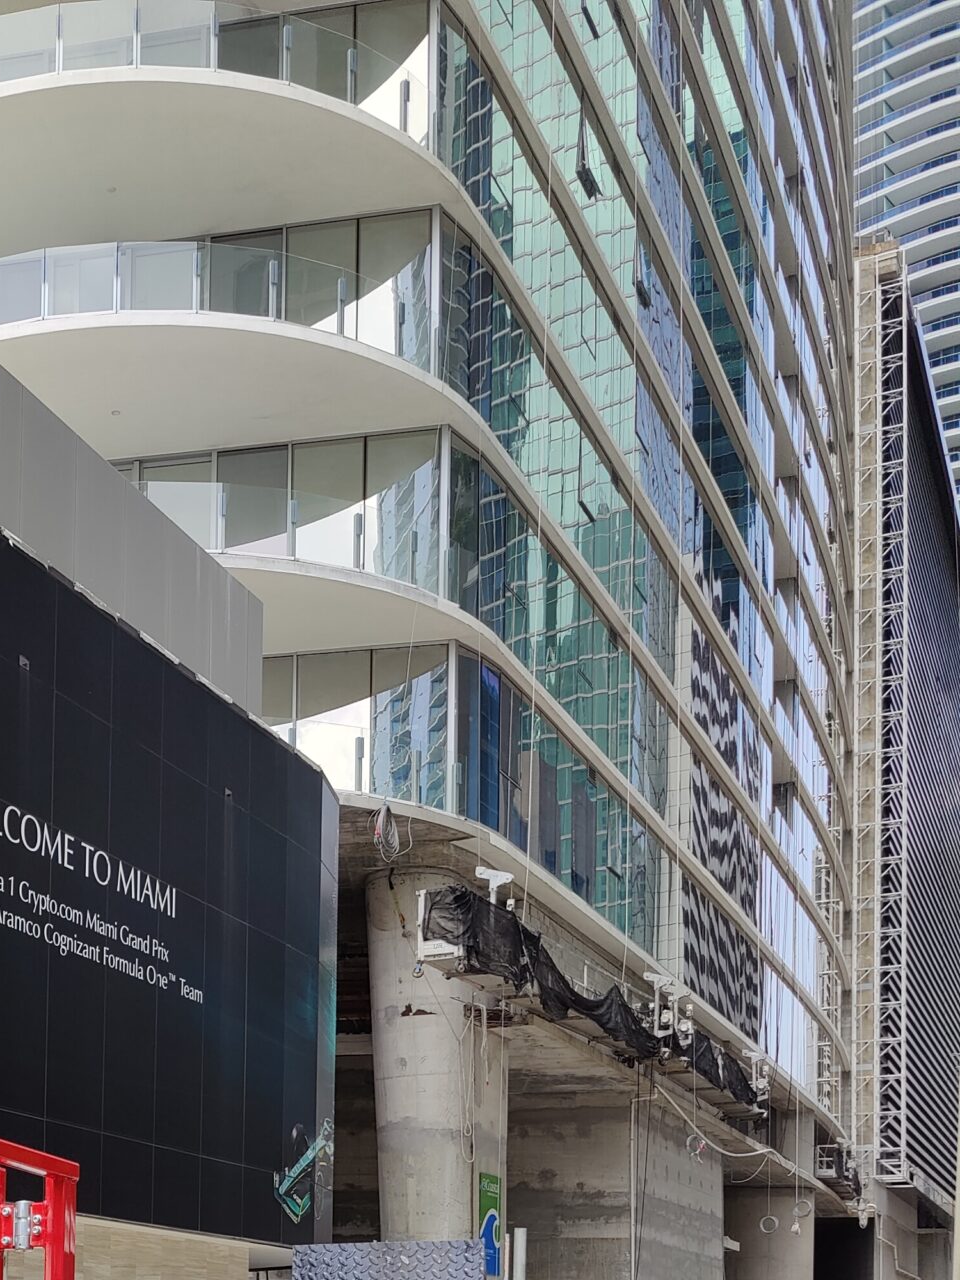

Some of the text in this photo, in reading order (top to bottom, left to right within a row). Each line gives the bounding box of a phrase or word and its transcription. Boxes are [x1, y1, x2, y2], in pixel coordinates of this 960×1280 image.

[8, 876, 15, 897] 1
[19, 881, 83, 926] Crypto.com
[85, 909, 117, 941] Miami
[119, 925, 150, 955] Grand
[151, 938, 170, 963] Prix
[81, 841, 111, 886] TO
[117, 860, 177, 919] MIAMI
[43, 923, 101, 964] Cognizant
[102, 946, 144, 981] Formula
[179, 977, 204, 1004] Team
